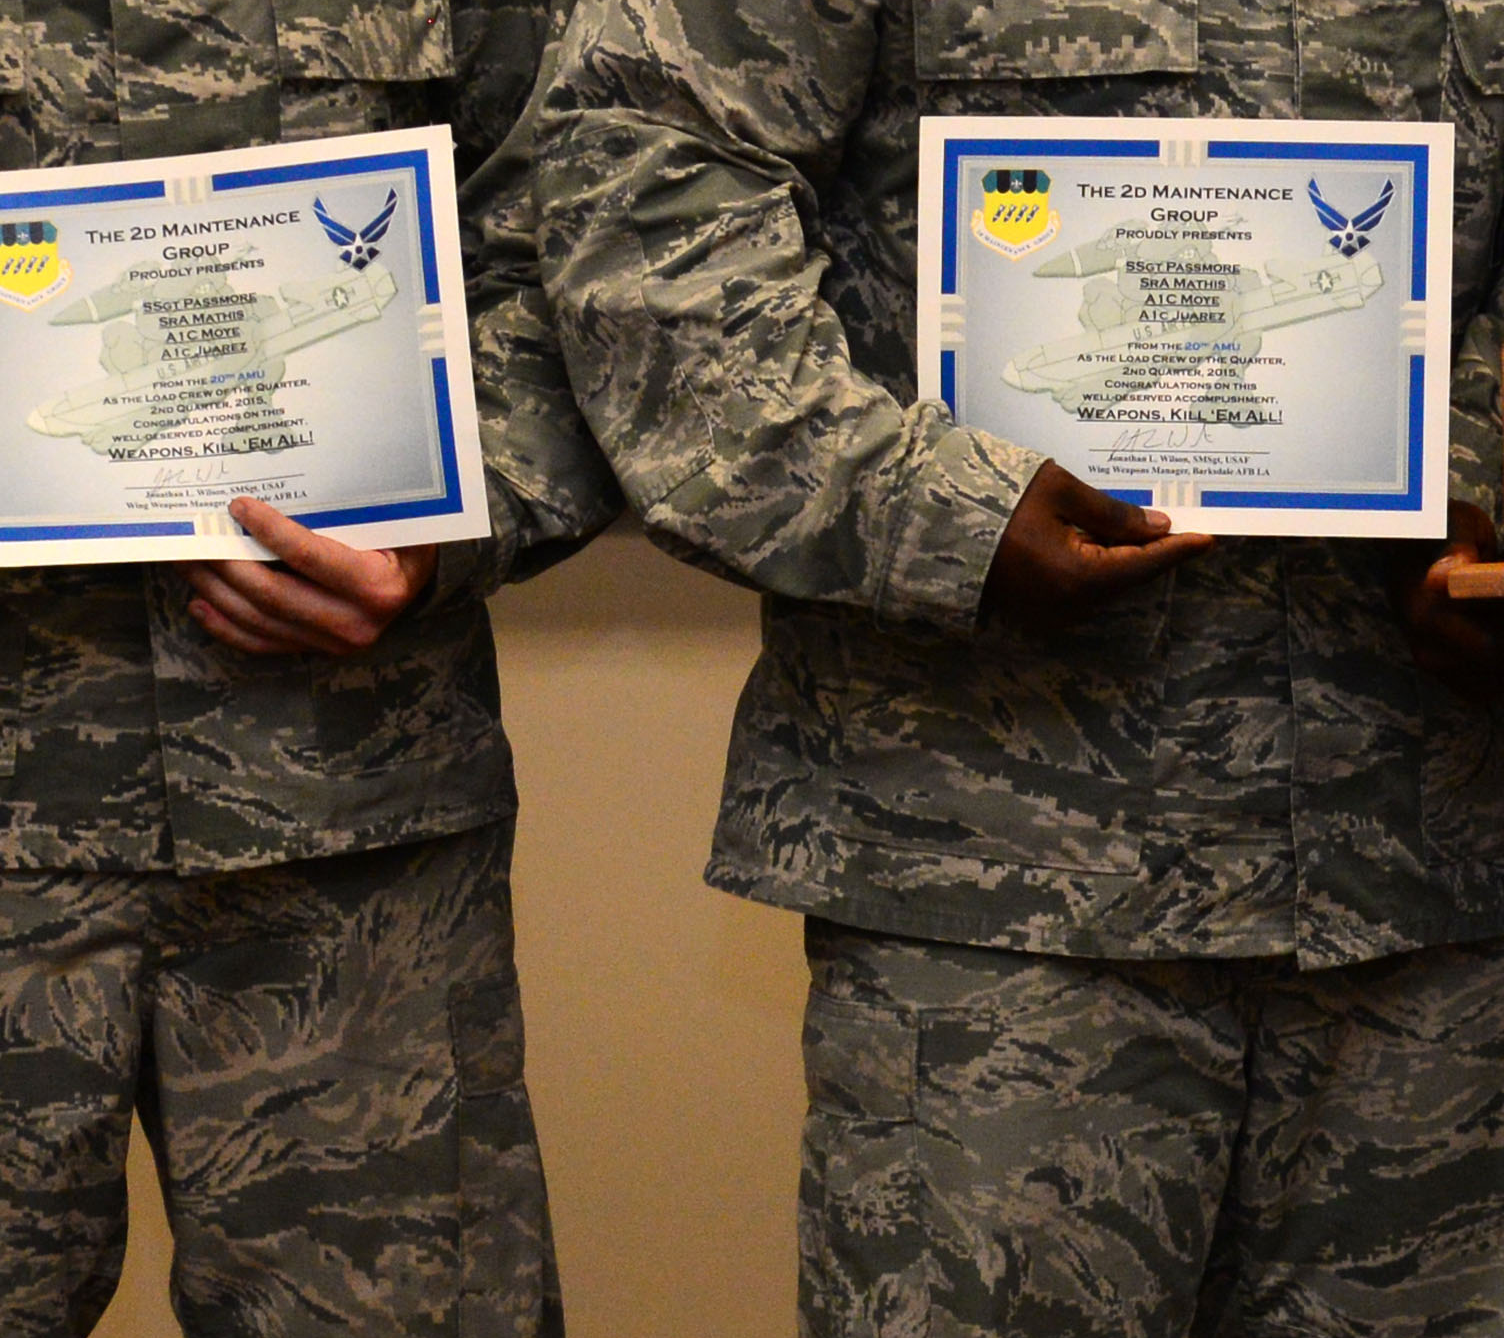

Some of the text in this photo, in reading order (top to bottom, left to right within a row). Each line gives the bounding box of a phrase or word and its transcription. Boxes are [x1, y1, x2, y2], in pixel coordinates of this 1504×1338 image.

[1077, 184, 1115, 198] THE
[1153, 185, 1293, 200] MAINTENANCE
[1151, 208, 1218, 222] GROUP
[85, 229, 125, 244] THE
[161, 211, 301, 236] MAINTENANCE
[1116, 229, 1252, 240] PROUDLY PRESENTS
[162, 241, 230, 259] GROUP
[129, 260, 265, 280] PROUDLY PRESENTS
[1174, 279, 1225, 289] MATHIS
[1145, 294, 1220, 305] A1C MOYE
[1139, 311, 1225, 322] A1C JUAREZ
[1104, 380, 1211, 390] CONGRATULATIONS
[1214, 382, 1230, 390] ON
[133, 413, 241, 428] CONGRATULATIONS
[1077, 408, 1165, 421] WEAPONS,
[1170, 408, 1207, 421] KILL
[1246, 411, 1283, 422] ALL!
[108, 445, 198, 461] WEAPONS,
[202, 440, 240, 453] KILL
[277, 433, 315, 446] ALL!
